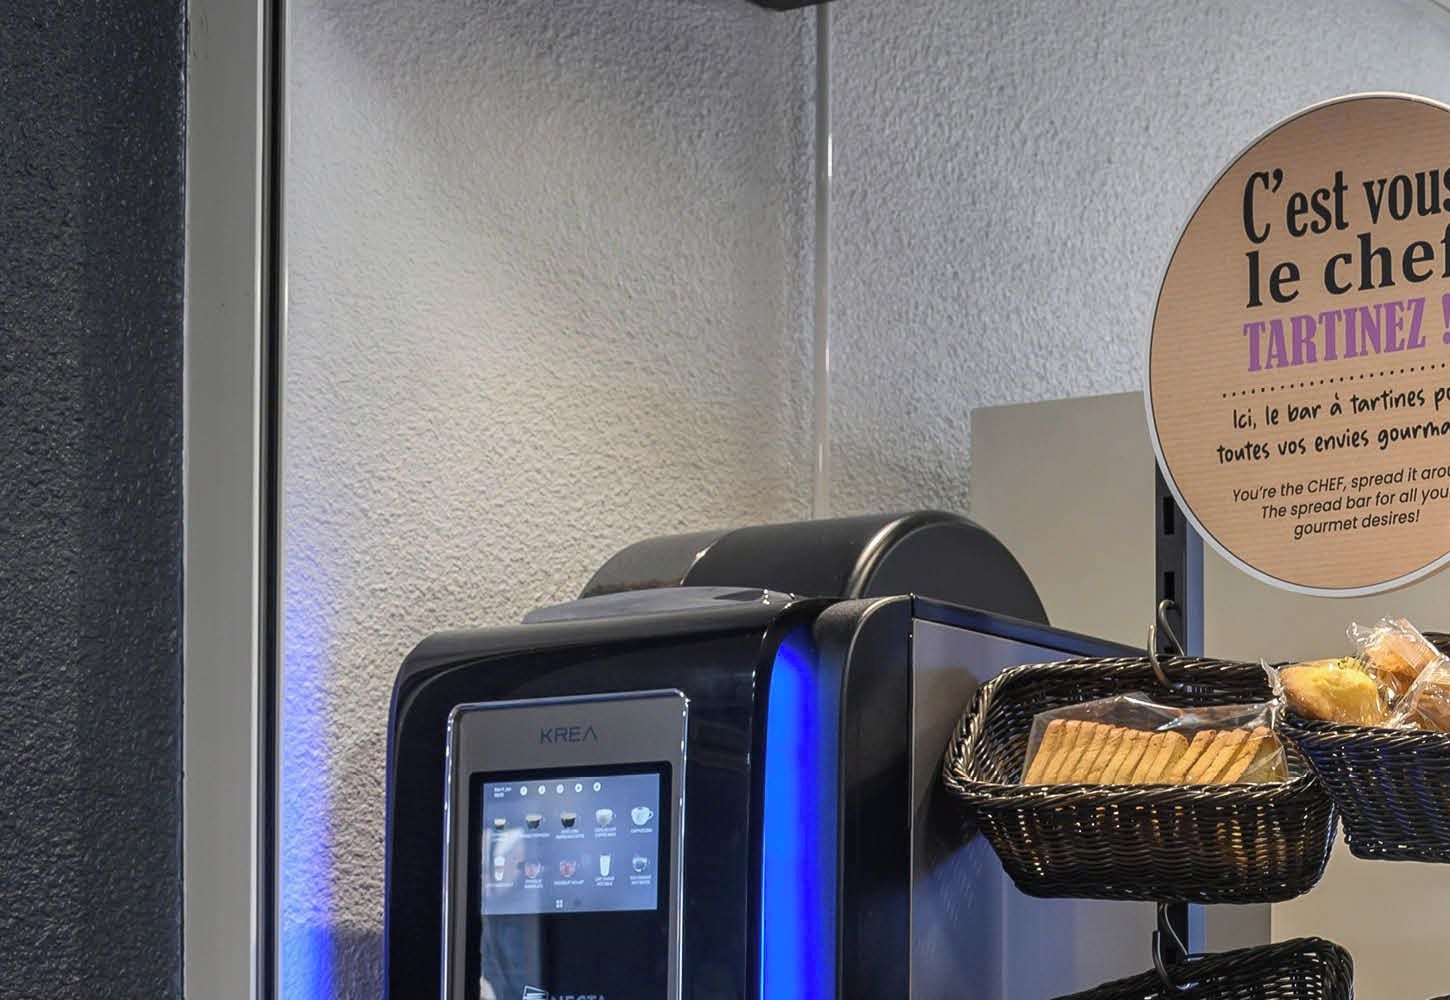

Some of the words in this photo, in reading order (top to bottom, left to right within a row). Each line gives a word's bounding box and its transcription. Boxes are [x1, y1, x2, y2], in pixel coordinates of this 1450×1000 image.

[1243, 168, 1349, 244] C'est
[1245, 251, 1300, 308] le
[1243, 297, 1426, 372] TARTINEZ
[1233, 409, 1257, 430] Ici,
[1266, 405, 1279, 426] le
[1288, 403, 1321, 423] bar
[1330, 392, 1342, 416] à
[1349, 388, 1425, 415] tartines
[1216, 442, 1270, 464] toutes
[1278, 438, 1306, 456] vos
[1314, 429, 1369, 452] envies
[1232, 485, 1277, 503] You're
[1280, 479, 1304, 496] the
[1307, 476, 1347, 494] CHEF,
[1351, 468, 1404, 491] spread
[1407, 467, 1417, 482] it
[1262, 503, 1287, 519] The
[1290, 494, 1342, 516] spread
[1346, 494, 1372, 509] bar
[1375, 490, 1396, 506] for
[1399, 486, 1417, 504] all
[1294, 517, 1358, 540] gourmet
[1361, 509, 1420, 529] desires!
